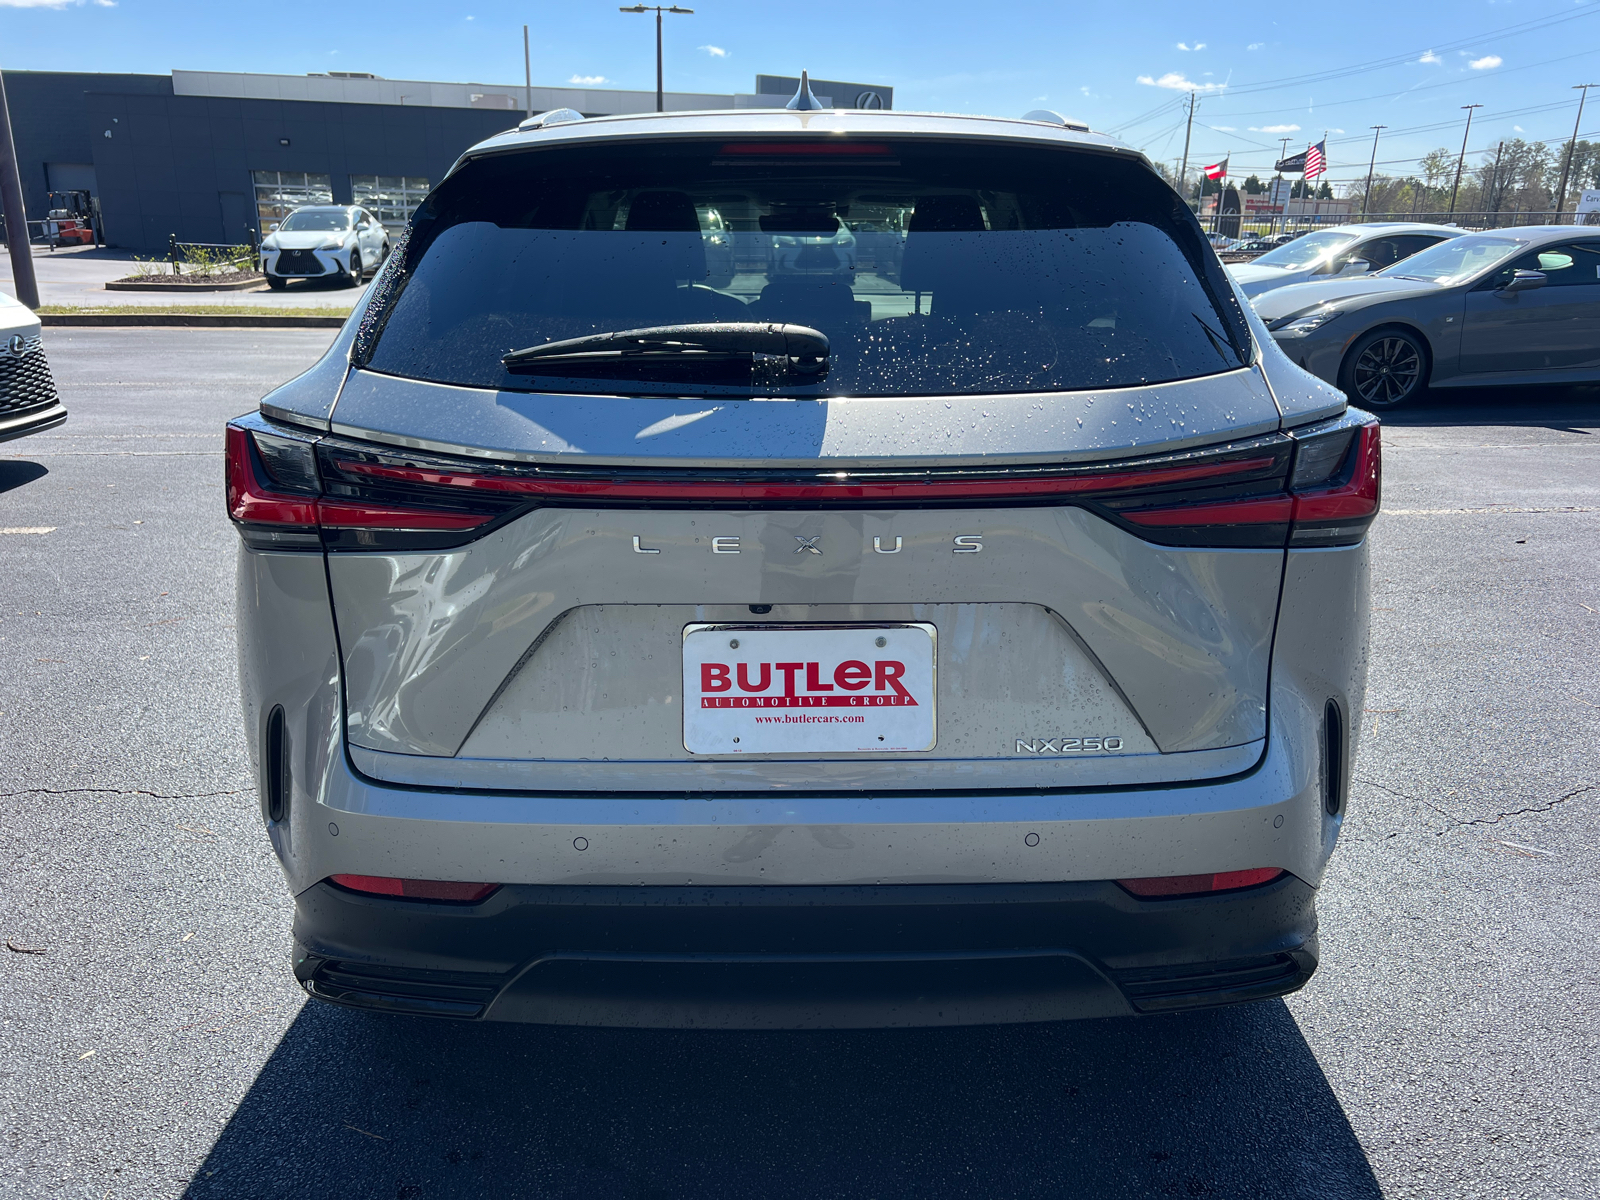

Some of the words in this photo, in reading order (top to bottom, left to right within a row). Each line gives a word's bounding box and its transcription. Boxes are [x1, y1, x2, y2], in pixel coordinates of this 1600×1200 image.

[632, 534, 984, 556] LEXUS
[702, 696, 829, 708] AUTOMOTIVE
[849, 695, 912, 706] GROUP
[755, 713, 865, 724] www.butlercars.com
[1015, 736, 1124, 754] NX250
